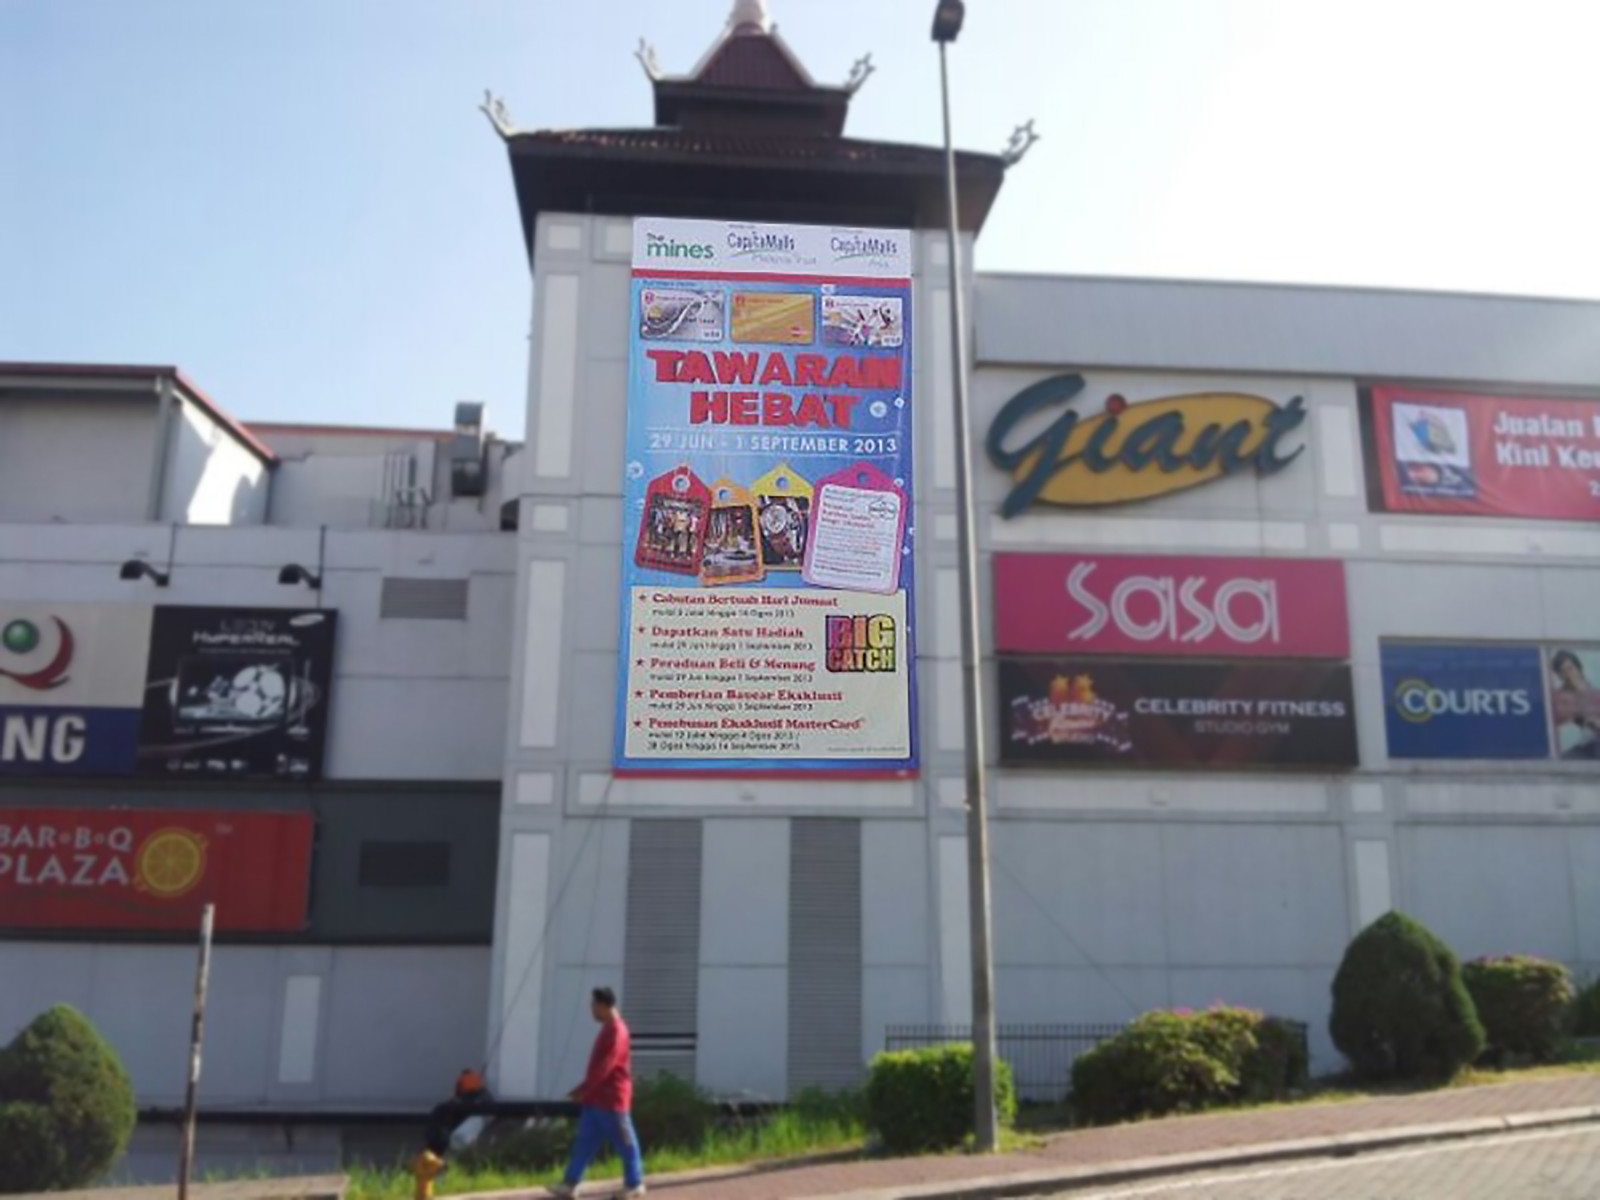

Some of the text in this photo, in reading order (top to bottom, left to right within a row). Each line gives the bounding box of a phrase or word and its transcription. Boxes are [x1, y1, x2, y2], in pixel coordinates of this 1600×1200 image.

[647, 239, 714, 259] mines
[646, 350, 901, 388] TAWARAN
[690, 390, 862, 428] HEBAT
[1493, 411, 1585, 438] Jualan
[651, 433, 673, 449] 29
[680, 434, 714, 449] JUN
[750, 437, 850, 452] SEPTEMBER
[855, 438, 898, 453] 2013
[985, 372, 1307, 520] Giant
[1496, 442, 1550, 467] Kini
[708, 594, 760, 605] Bertuah
[761, 595, 790, 606] Hari
[652, 626, 804, 638] Dapatkan Satu Hadiah
[825, 613, 896, 649] BIG
[650, 657, 816, 672] Peraduan Beli & Menang
[825, 648, 896, 672] CATCH
[649, 688, 723, 700] Pemberian
[1400, 687, 1532, 716] COURTS
[1134, 697, 1346, 717] CELEBRITY FITNESS
